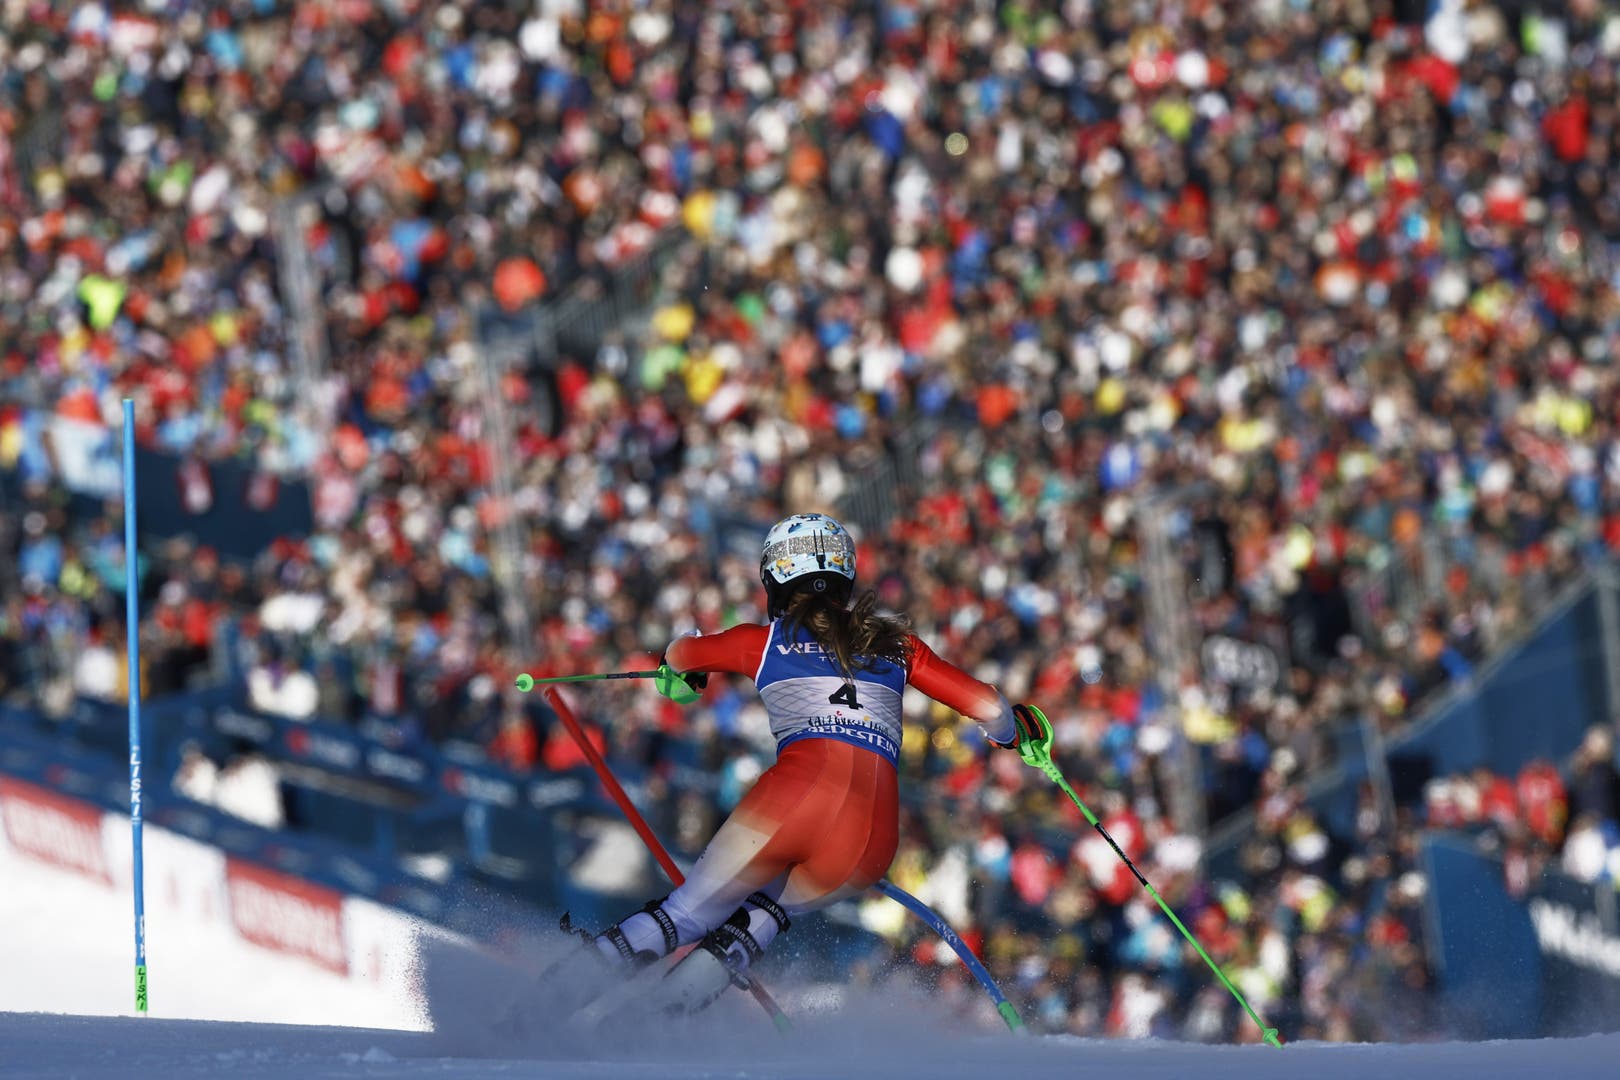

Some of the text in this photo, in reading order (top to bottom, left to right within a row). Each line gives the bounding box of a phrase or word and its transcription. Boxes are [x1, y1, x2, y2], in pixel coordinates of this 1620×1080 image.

[829, 684, 863, 709] 4
[800, 725, 897, 758] REDESTEIN
[130, 752, 141, 816] LISKI
[137, 968, 146, 1010] LISKI
